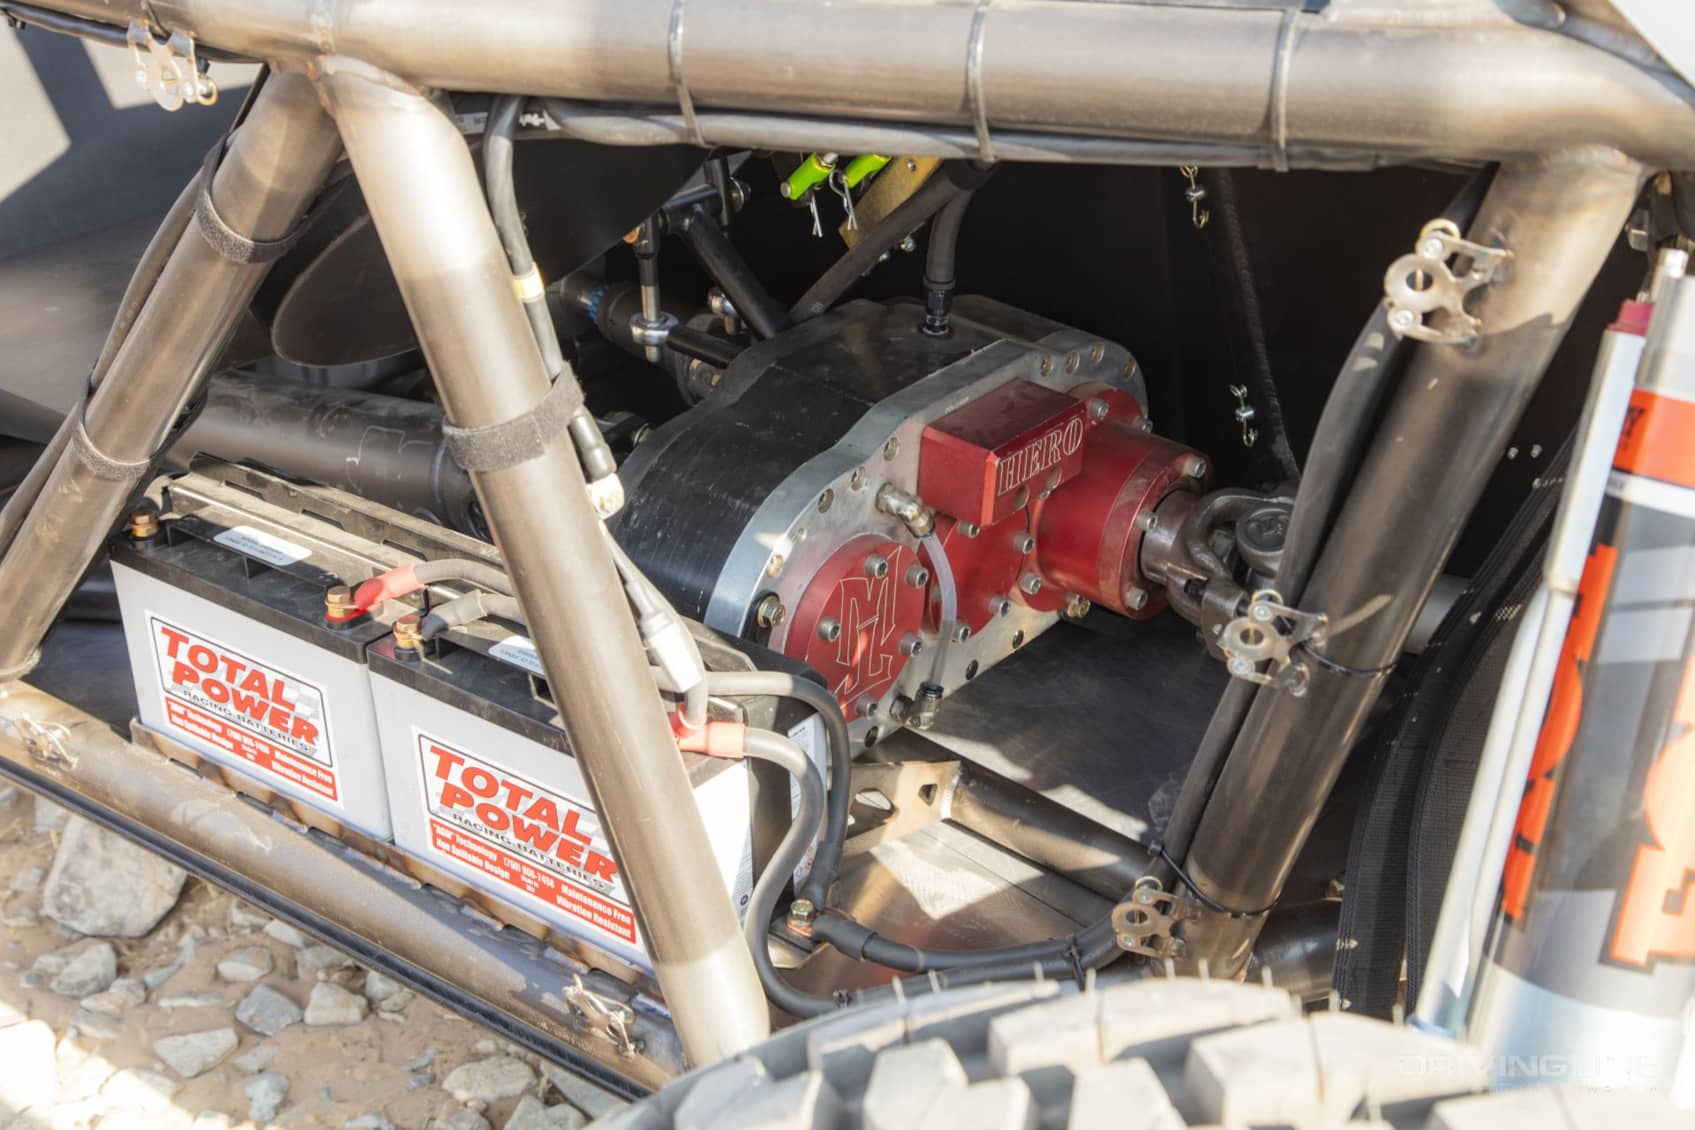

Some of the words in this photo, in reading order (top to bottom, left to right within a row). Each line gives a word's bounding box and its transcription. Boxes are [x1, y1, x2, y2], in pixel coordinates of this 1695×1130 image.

[998, 417, 1083, 496] HERO
[161, 627, 295, 711] TOTAL
[172, 661, 318, 745] POWER
[184, 690, 232, 716] RACING
[237, 714, 309, 751] BATTERIES
[430, 745, 592, 846] TOTAL
[439, 782, 617, 884] POWER
[453, 813, 511, 846] RACING
[518, 841, 605, 890] BATTERIES
[556, 895, 593, 918] Vibration
[593, 910, 631, 938] Resistant
[561, 883, 613, 917] Maintenance
[613, 905, 631, 926] Free
